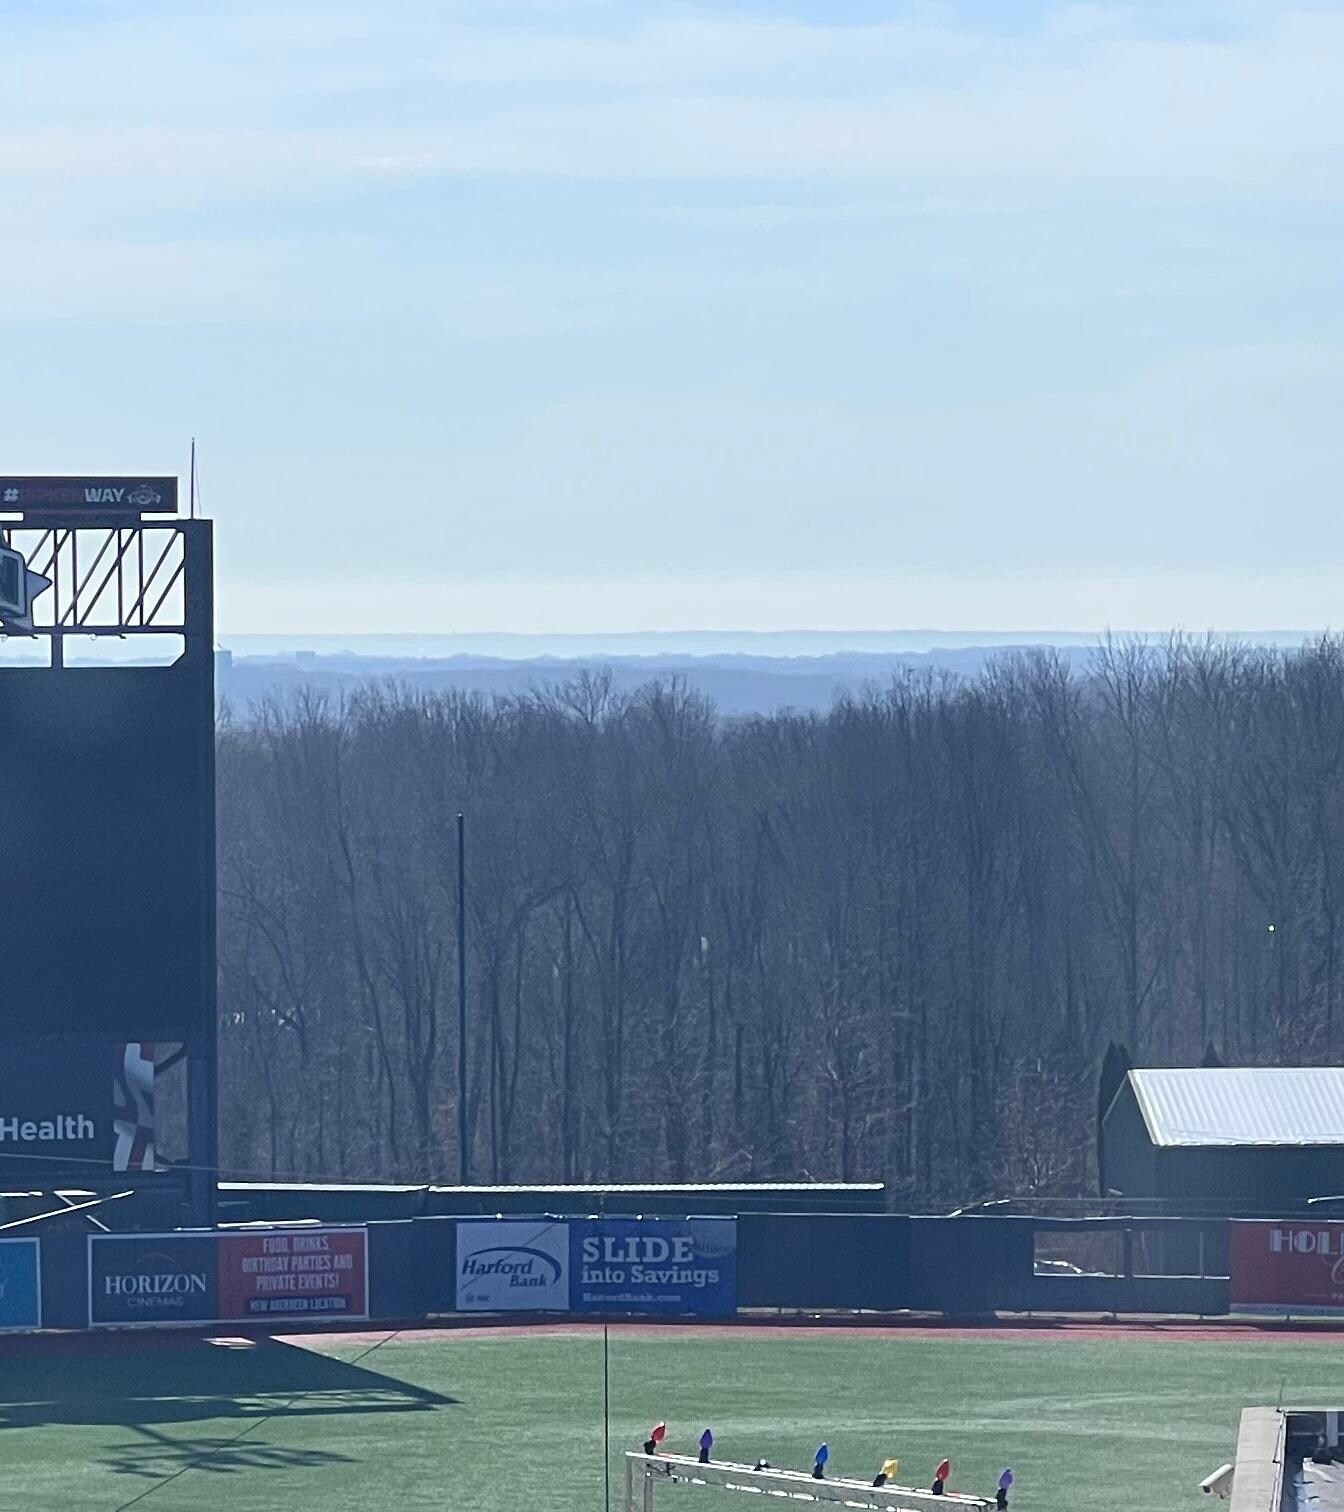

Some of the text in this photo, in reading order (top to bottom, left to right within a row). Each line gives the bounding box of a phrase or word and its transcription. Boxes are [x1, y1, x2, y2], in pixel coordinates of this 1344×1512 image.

[0, 1114, 94, 1141] Health
[582, 1236, 694, 1263] SLIDE
[333, 1254, 353, 1270] AND
[461, 1259, 535, 1275] Harford
[105, 1272, 207, 1294] HORIZON
[509, 1273, 547, 1287] Bank
[581, 1265, 719, 1288] into Savings
[127, 1297, 185, 1307] CINEMAS
